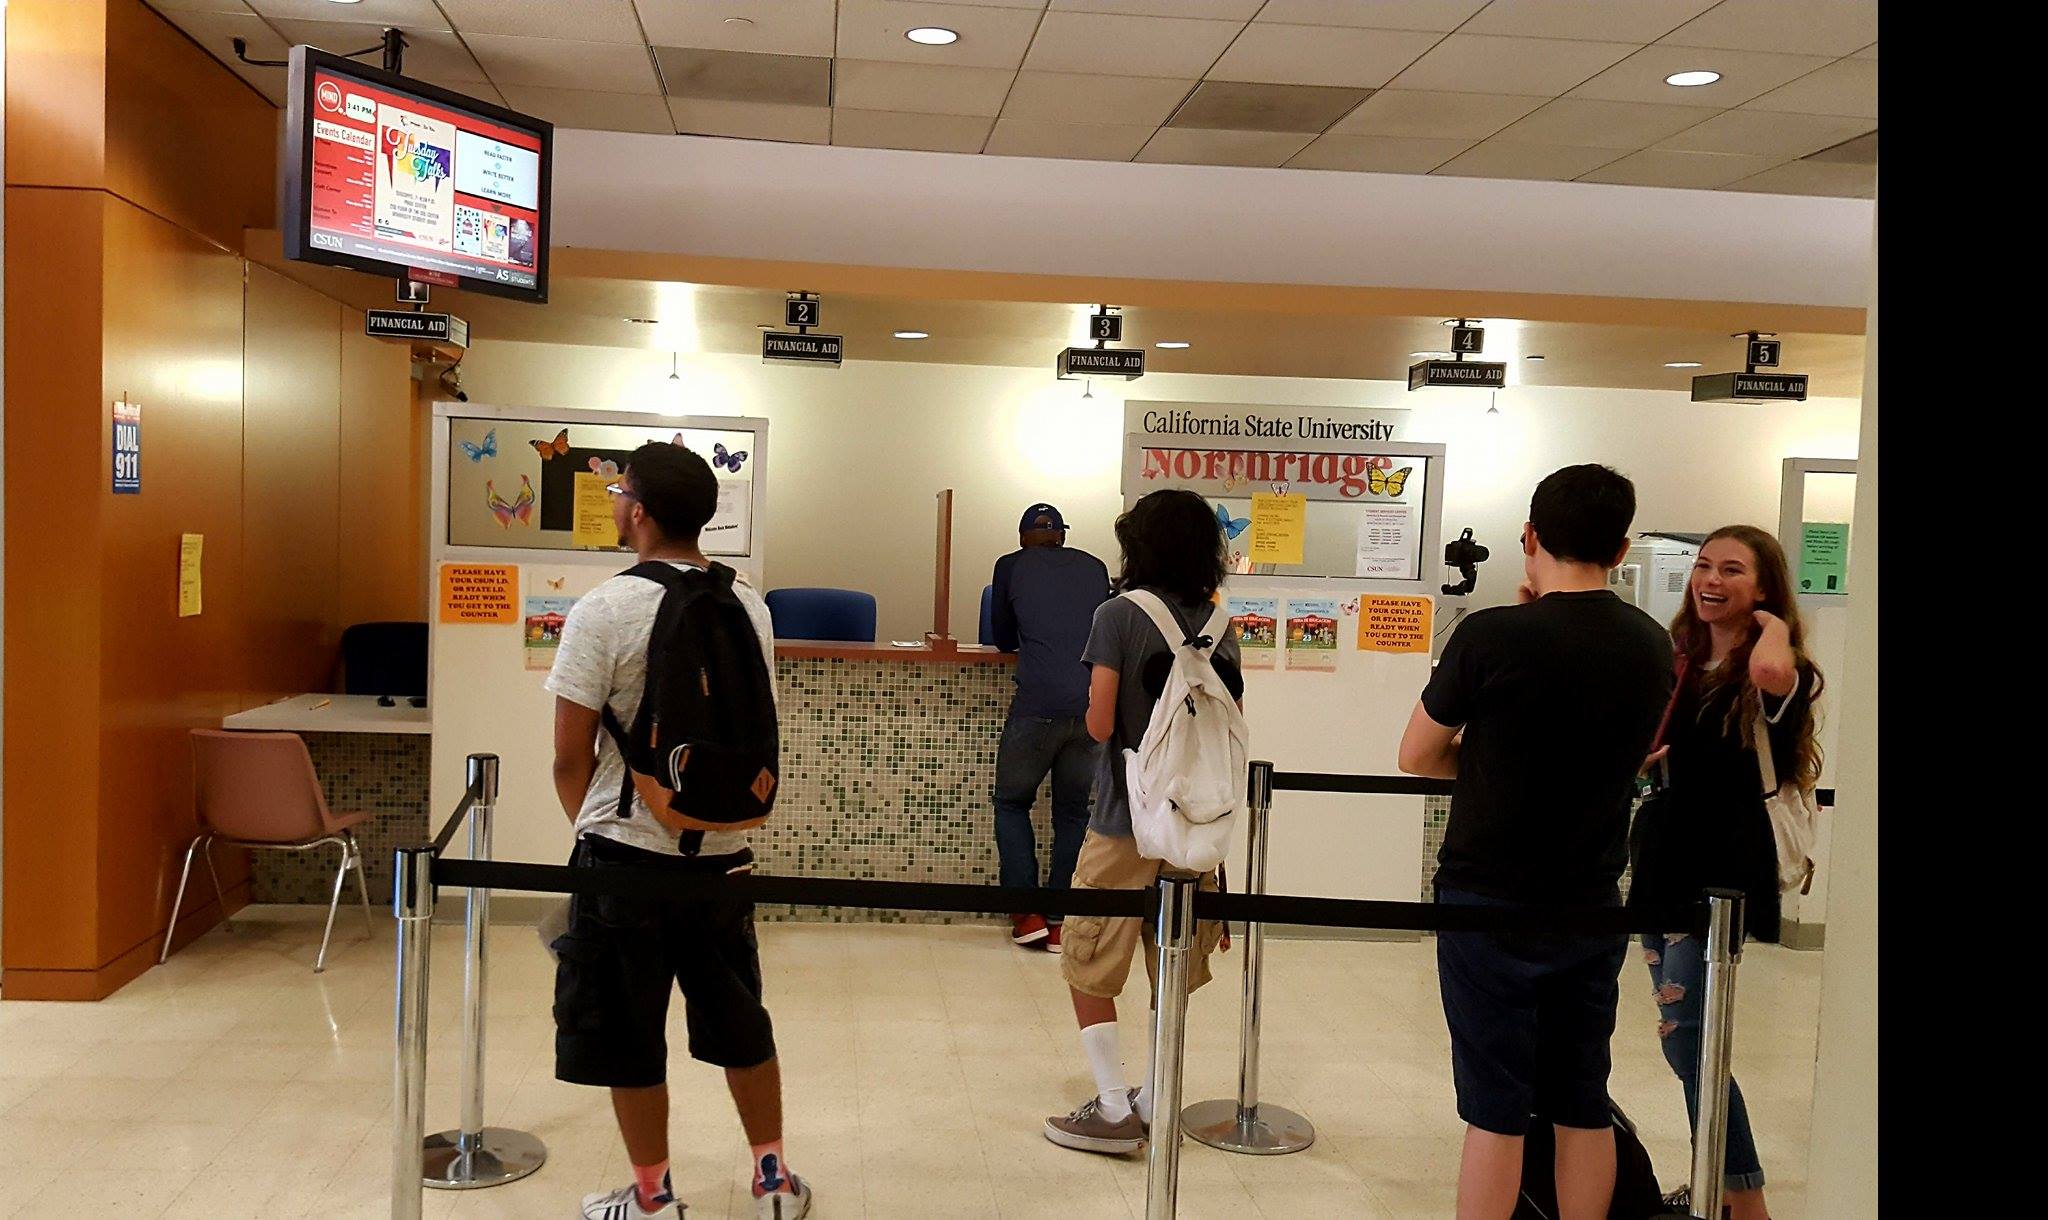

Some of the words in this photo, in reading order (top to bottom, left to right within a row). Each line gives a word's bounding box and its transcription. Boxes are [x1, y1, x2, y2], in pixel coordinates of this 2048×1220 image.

[362, 106, 372, 115] PM
[316, 122, 340, 139] Events
[341, 128, 372, 147] Calendar
[481, 186, 496, 196] LEARN
[498, 191, 511, 199] MORE
[313, 233, 343, 248] CSUN
[496, 270, 509, 281] AS
[409, 281, 417, 299] 1
[798, 304, 808, 322] 2
[370, 316, 424, 330] FINANCIAL
[428, 320, 445, 332] AID
[1100, 319, 1110, 337] 3
[768, 340, 818, 353] FINANCIAL
[821, 343, 838, 353] AID
[1462, 331, 1473, 349] 4
[1071, 355, 1121, 367] FINANCIAL
[1124, 357, 1141, 368] AID
[1760, 345, 1769, 363] 5
[1429, 367, 1482, 379] FINANCIAL
[1485, 369, 1502, 380] AID
[1737, 380, 1785, 392] FINANCIAL
[1788, 382, 1804, 393] AID
[1143, 411, 1240, 436] California
[1244, 414, 1292, 438] State
[1298, 416, 1394, 442] University
[116, 424, 139, 452] DIAL
[115, 453, 138, 479] 911
[1400, 600, 1422, 608] HAVE
[1302, 634, 1312, 642] 23
[1375, 640, 1412, 648] COUNTER
